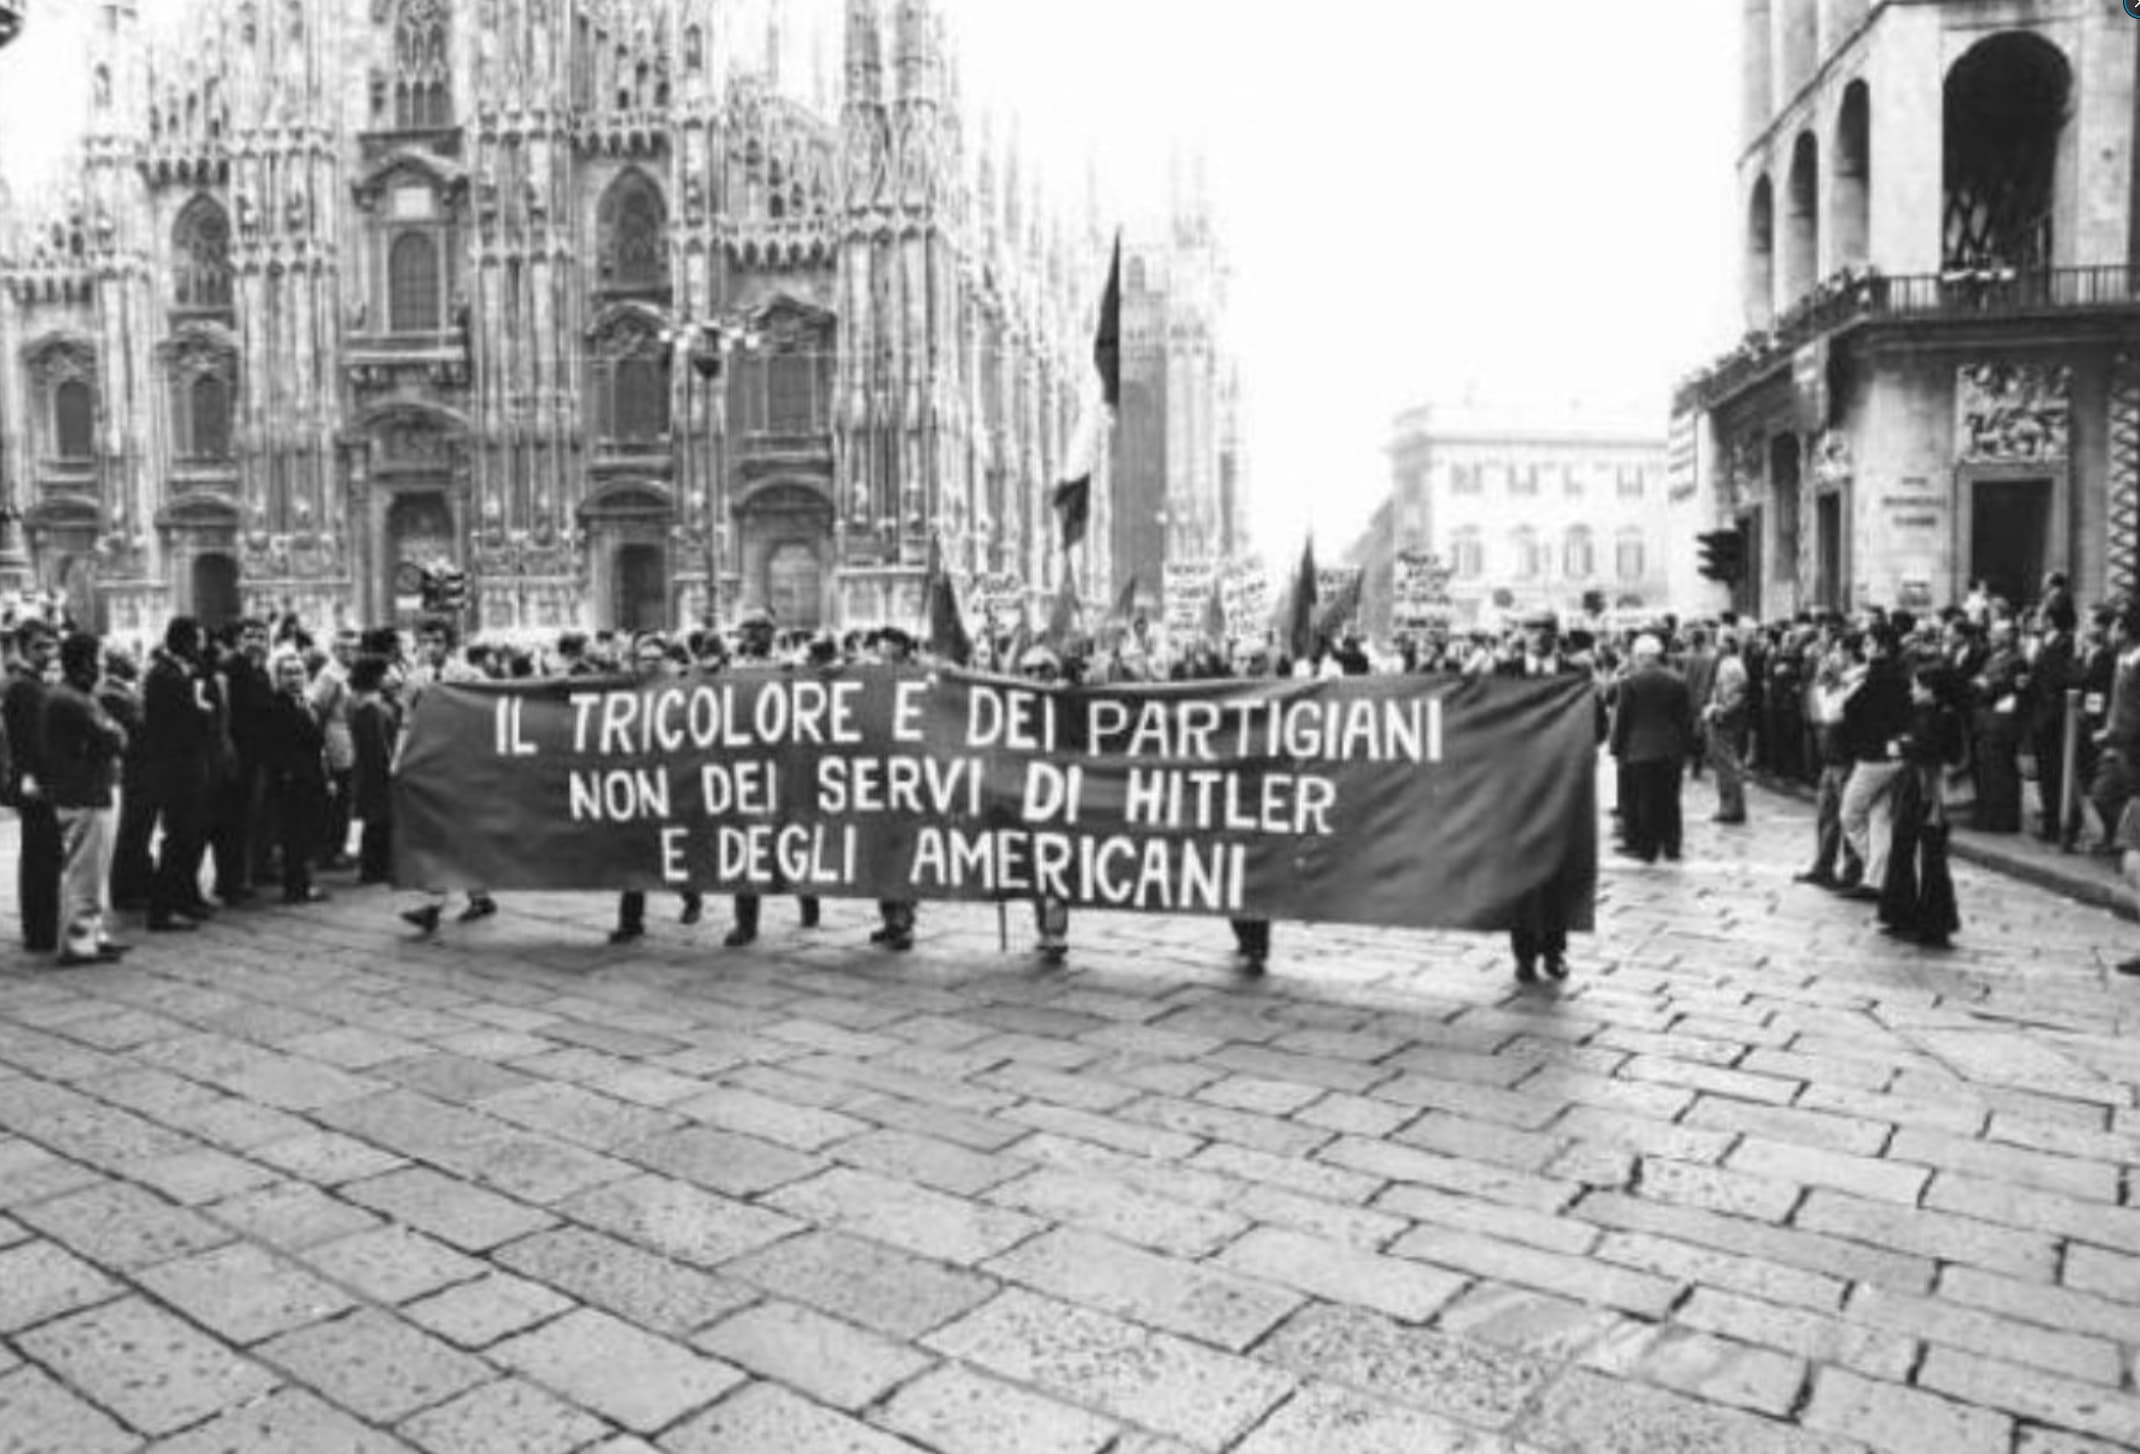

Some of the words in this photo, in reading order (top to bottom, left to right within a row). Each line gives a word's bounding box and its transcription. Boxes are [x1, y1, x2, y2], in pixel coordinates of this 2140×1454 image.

[495, 696, 538, 755] IL
[568, 680, 864, 754] TRICOLORE
[965, 684, 1055, 753] DEI
[1087, 697, 1443, 763] PARTIGIANI
[569, 767, 670, 821] NON
[701, 760, 777, 814] DEI
[817, 755, 983, 816] SERVI
[1021, 760, 1084, 824] DI
[1125, 768, 1337, 835] HITLER
[661, 827, 690, 881] E
[718, 823, 857, 883] DEGLI
[909, 827, 1247, 909] AMERICANI
